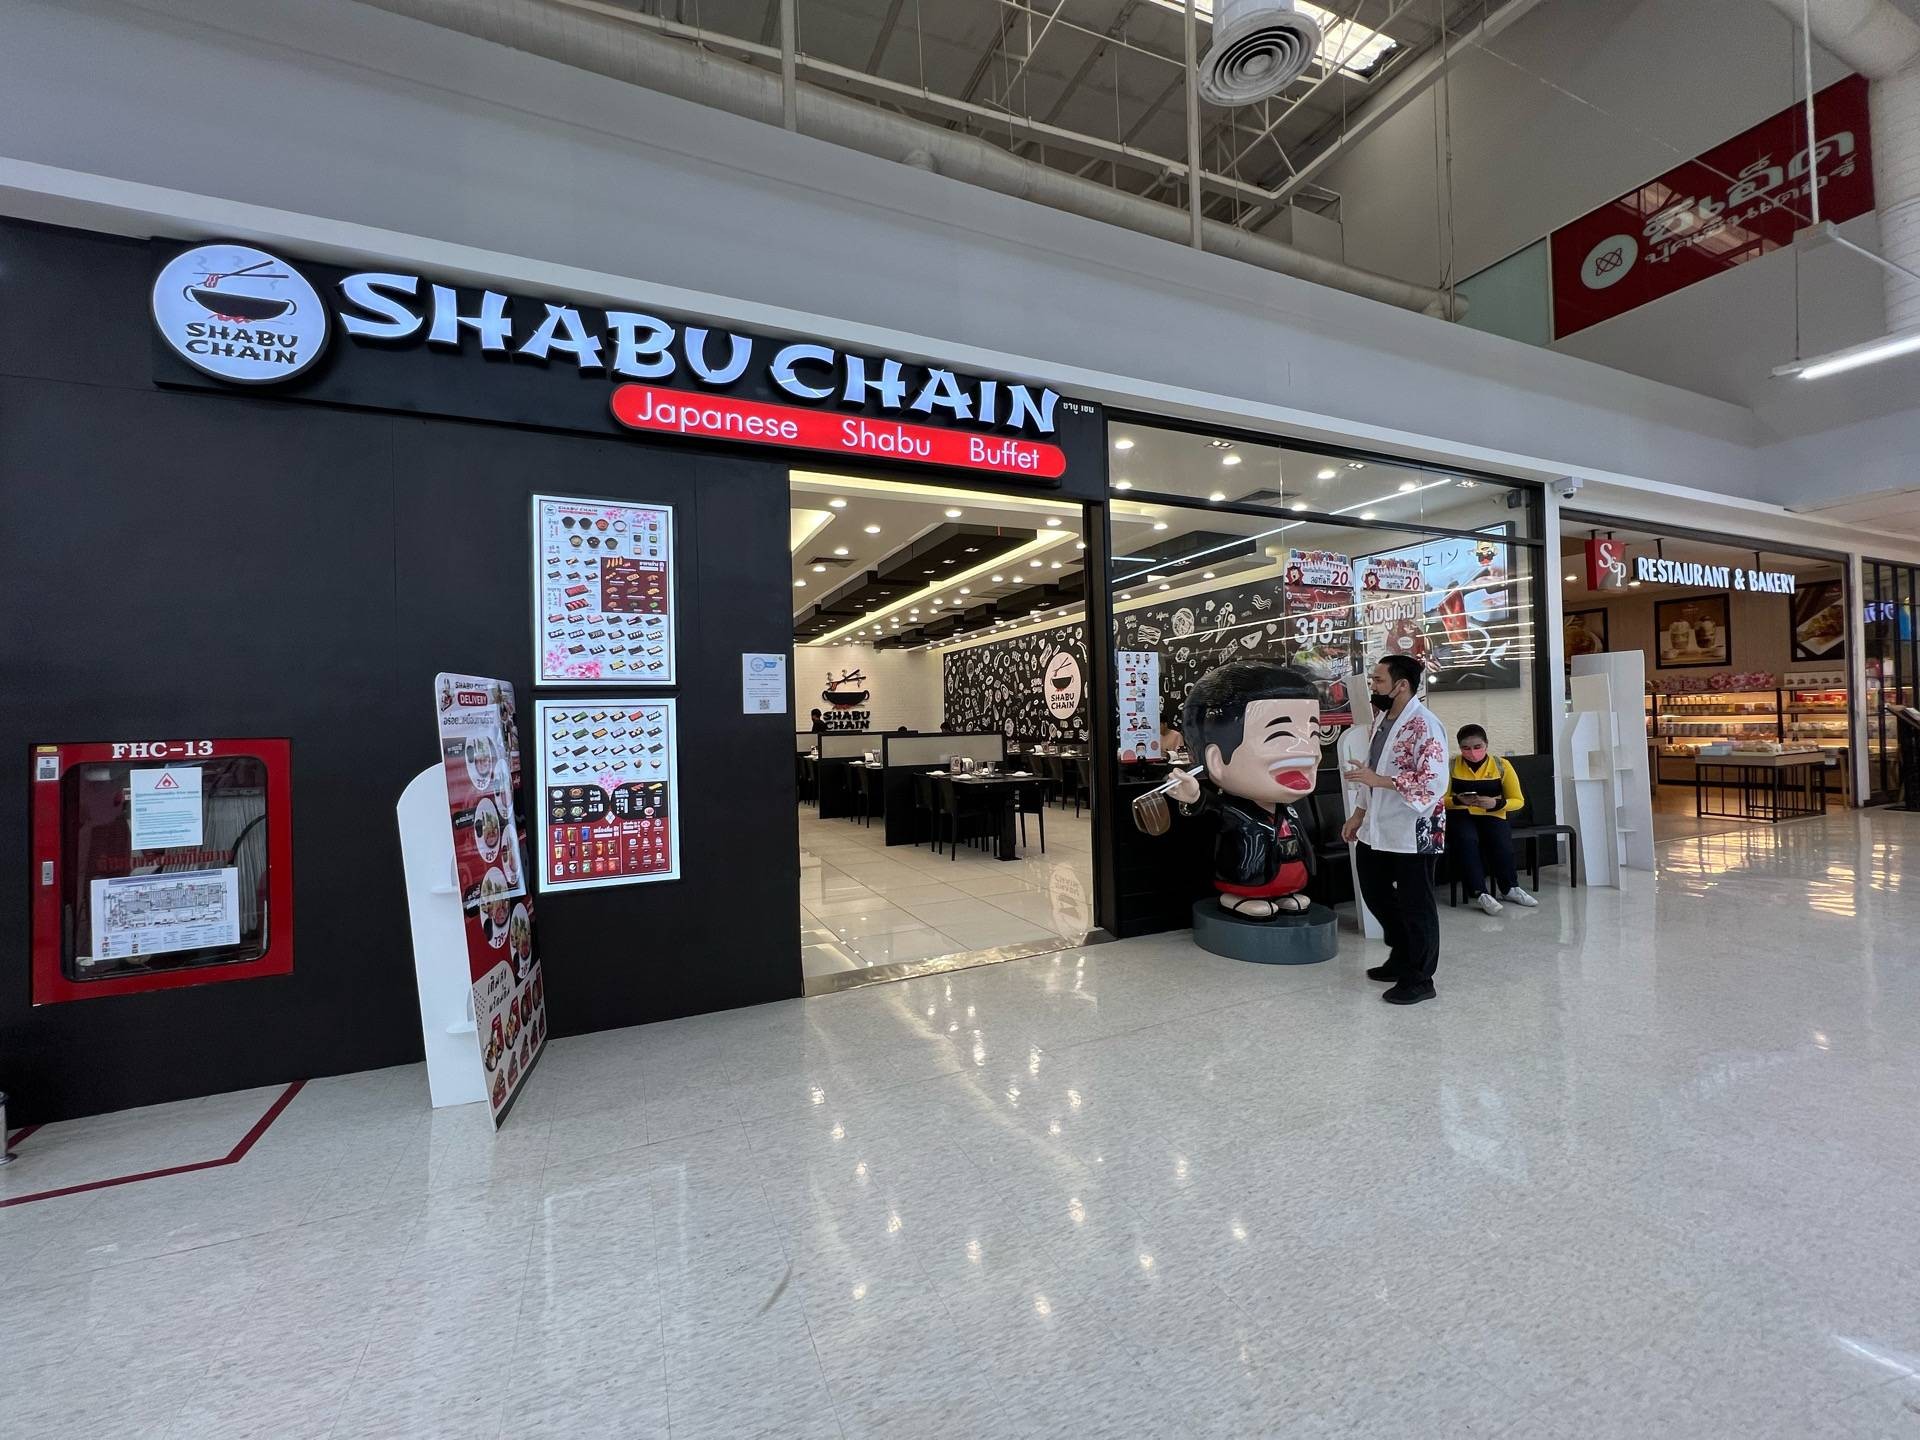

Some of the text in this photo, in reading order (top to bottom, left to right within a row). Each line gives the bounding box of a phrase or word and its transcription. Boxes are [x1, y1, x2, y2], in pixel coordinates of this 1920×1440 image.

[186, 322, 298, 348] SHABU
[186, 340, 297, 364] CHAIN
[339, 272, 1060, 433] SHABU CHAIN
[1063, 402, 1078, 415] ชาบู
[637, 391, 1040, 470] Japanese Shabu Buffet
[1404, 576, 1420, 590] 20
[1637, 557, 1796, 595] RESTAURANT & BAKERY
[1369, 596, 1417, 631] เมนูใหม่
[1334, 620, 1347, 628] NET
[460, 695, 487, 704] DELIVERY
[1050, 693, 1075, 702] SHABU
[1050, 702, 1075, 710] CHAIN
[823, 711, 870, 720] SHABU
[825, 720, 870, 730] CHAIN
[112, 740, 213, 758] FHC-13
